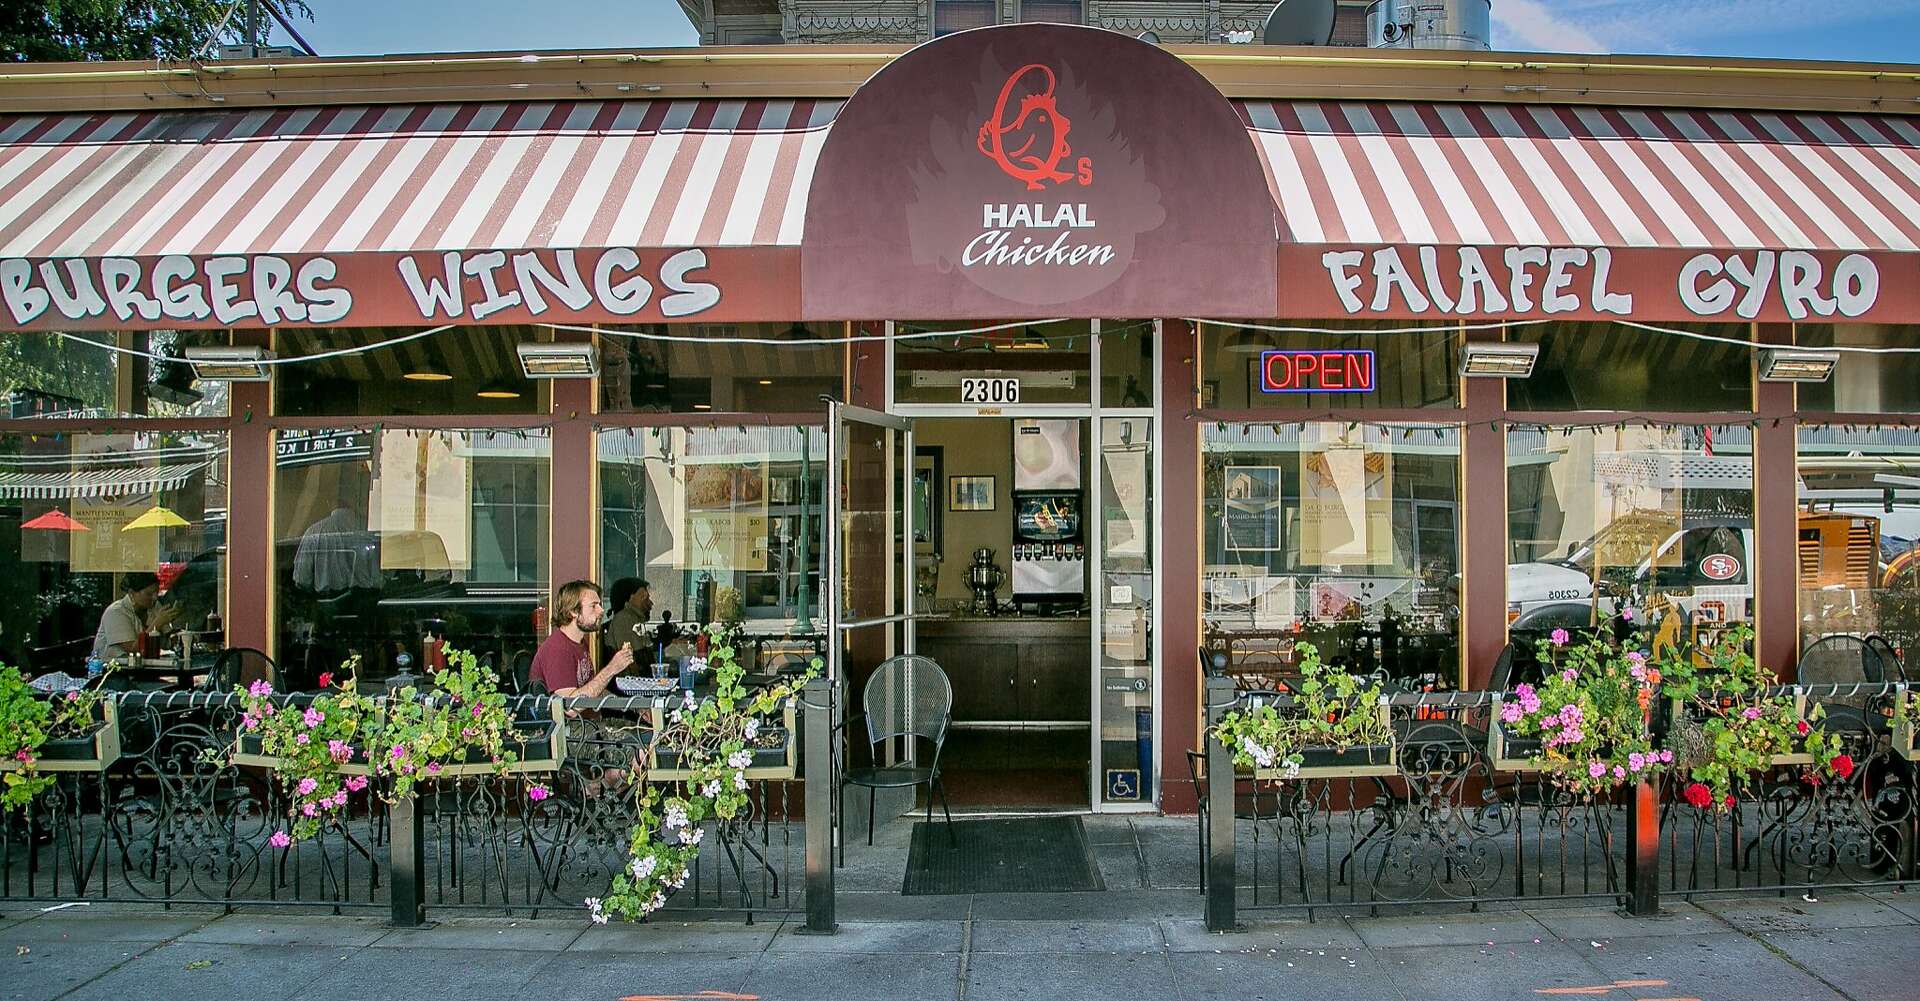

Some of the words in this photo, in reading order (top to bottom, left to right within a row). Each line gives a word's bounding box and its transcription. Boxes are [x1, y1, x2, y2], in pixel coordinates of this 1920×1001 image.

[983, 203, 1096, 229] HALAL
[961, 229, 1116, 267] Chicken
[0, 254, 353, 325] BURGERS
[397, 248, 721, 320] WINGS
[1677, 249, 1881, 320] GYRO
[1264, 352, 1372, 390] OPEN
[963, 379, 1018, 402] 2306
